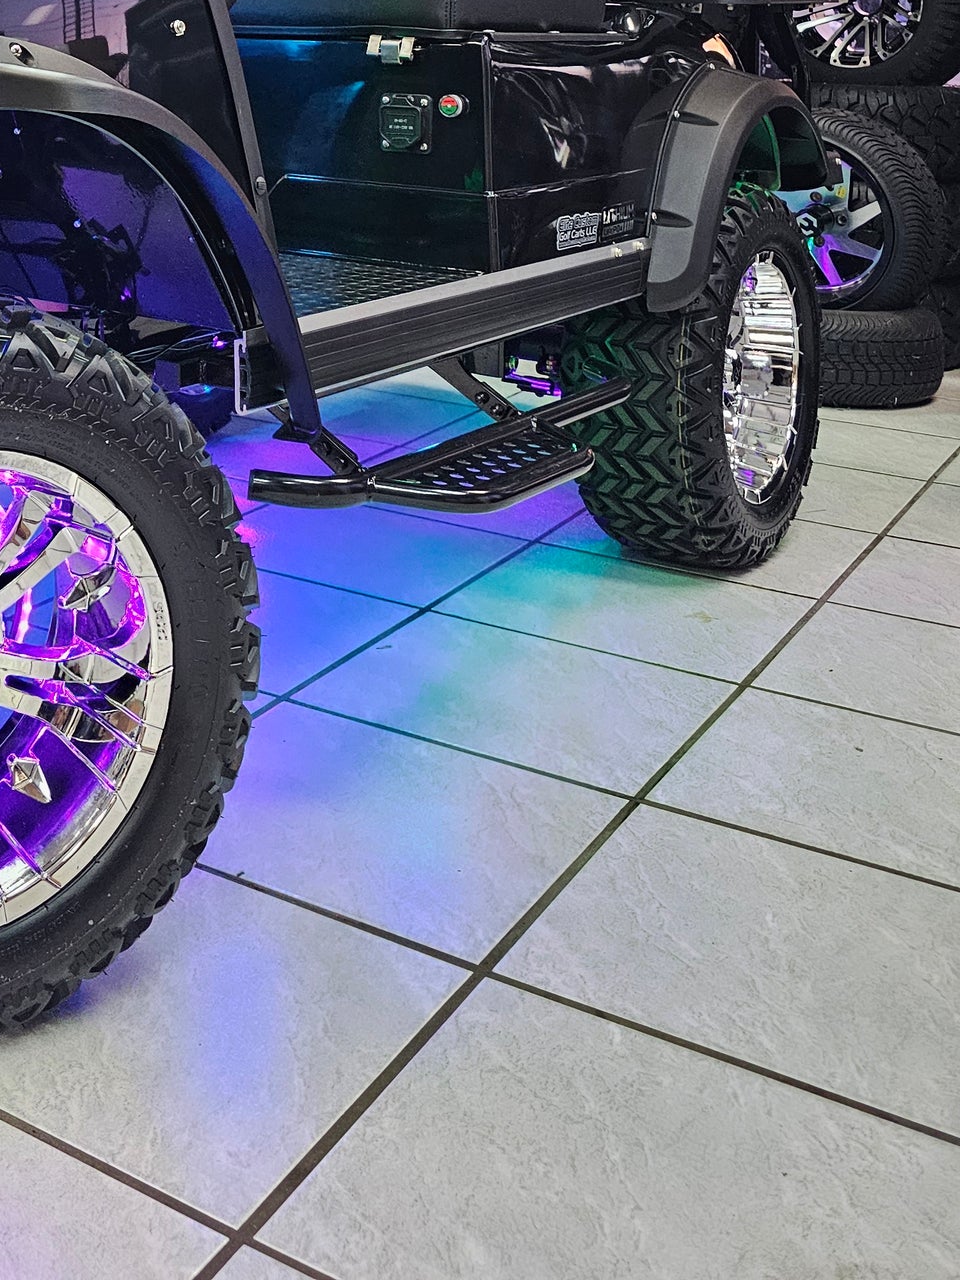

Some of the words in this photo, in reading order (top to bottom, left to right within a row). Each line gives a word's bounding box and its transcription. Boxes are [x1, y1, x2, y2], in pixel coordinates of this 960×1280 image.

[574, 215, 599, 229] Custom
[559, 231, 571, 241] Golf
[571, 228, 586, 239] Carts
[585, 226, 598, 236] LLC
